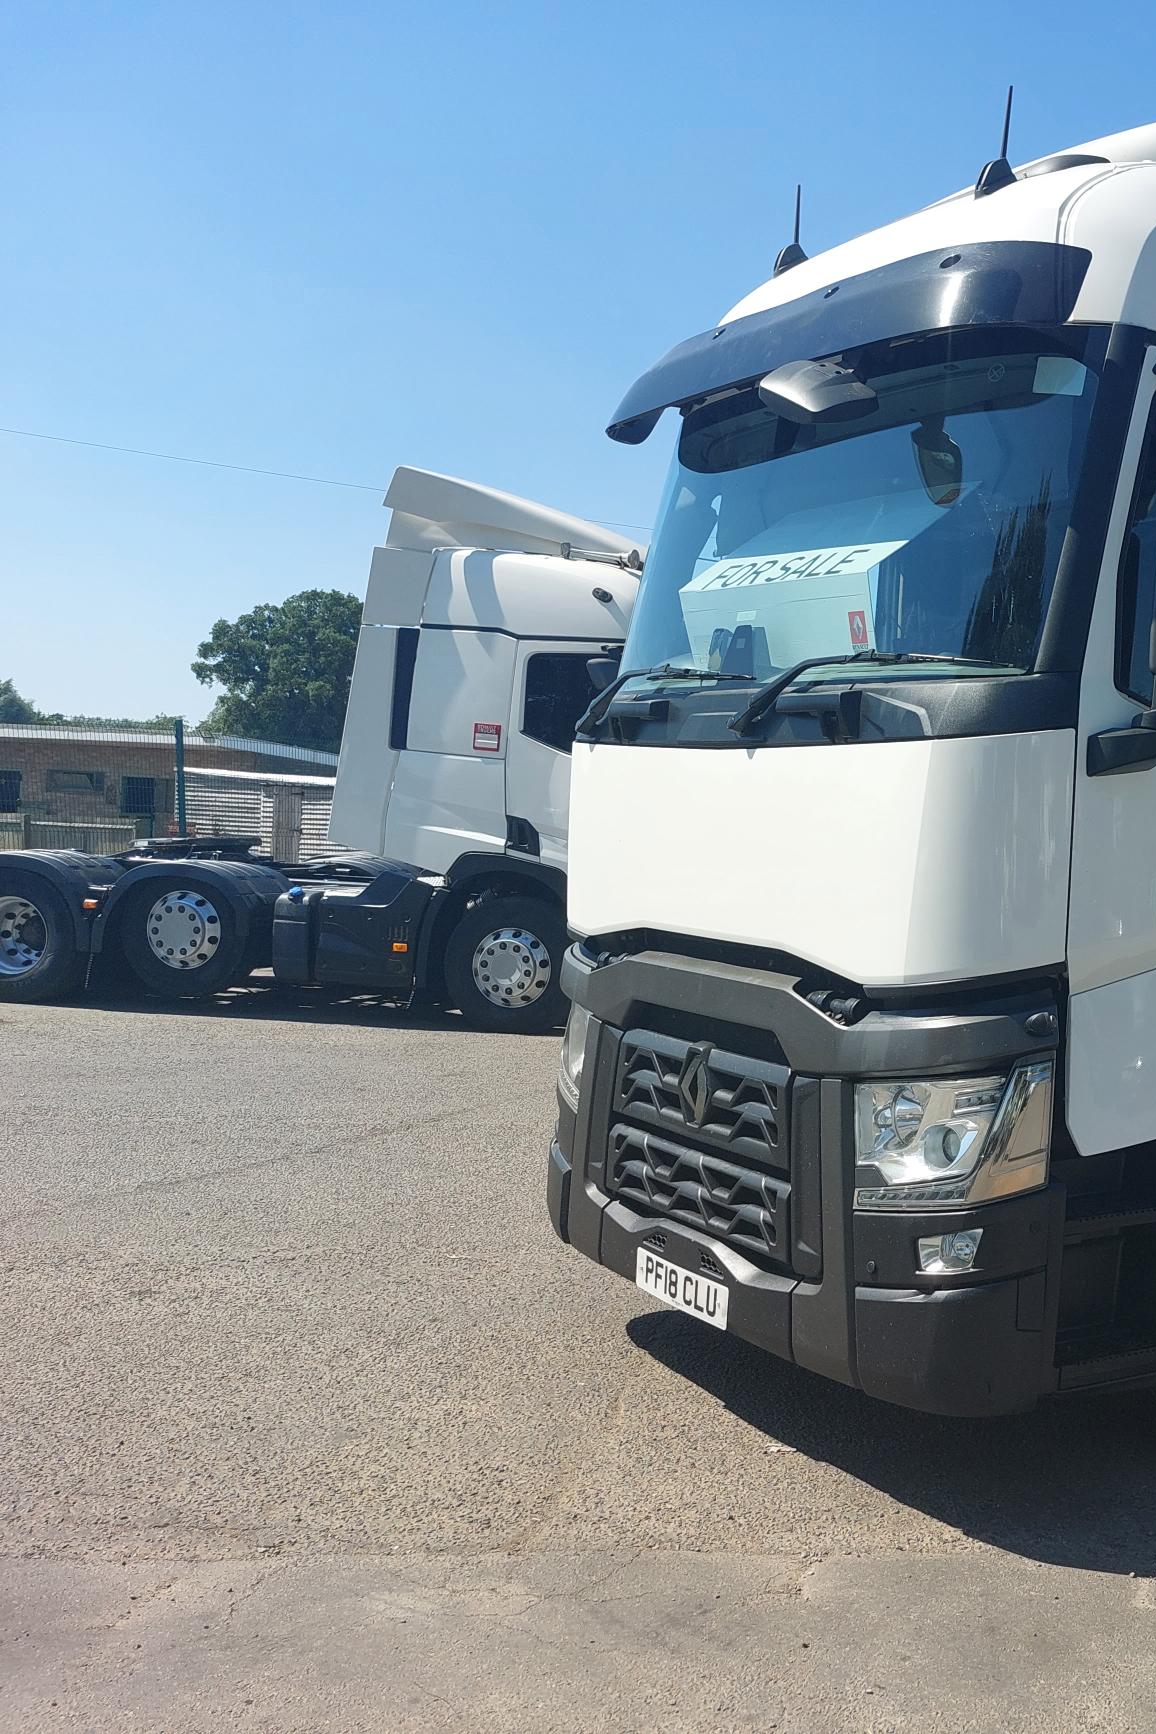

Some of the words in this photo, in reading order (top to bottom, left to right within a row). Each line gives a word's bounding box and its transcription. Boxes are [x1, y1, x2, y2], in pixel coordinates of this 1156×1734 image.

[701, 559, 778, 591] FOR
[765, 548, 871, 583] SALE
[645, 1255, 679, 1299] PF18
[682, 1275, 718, 1318] CLU
